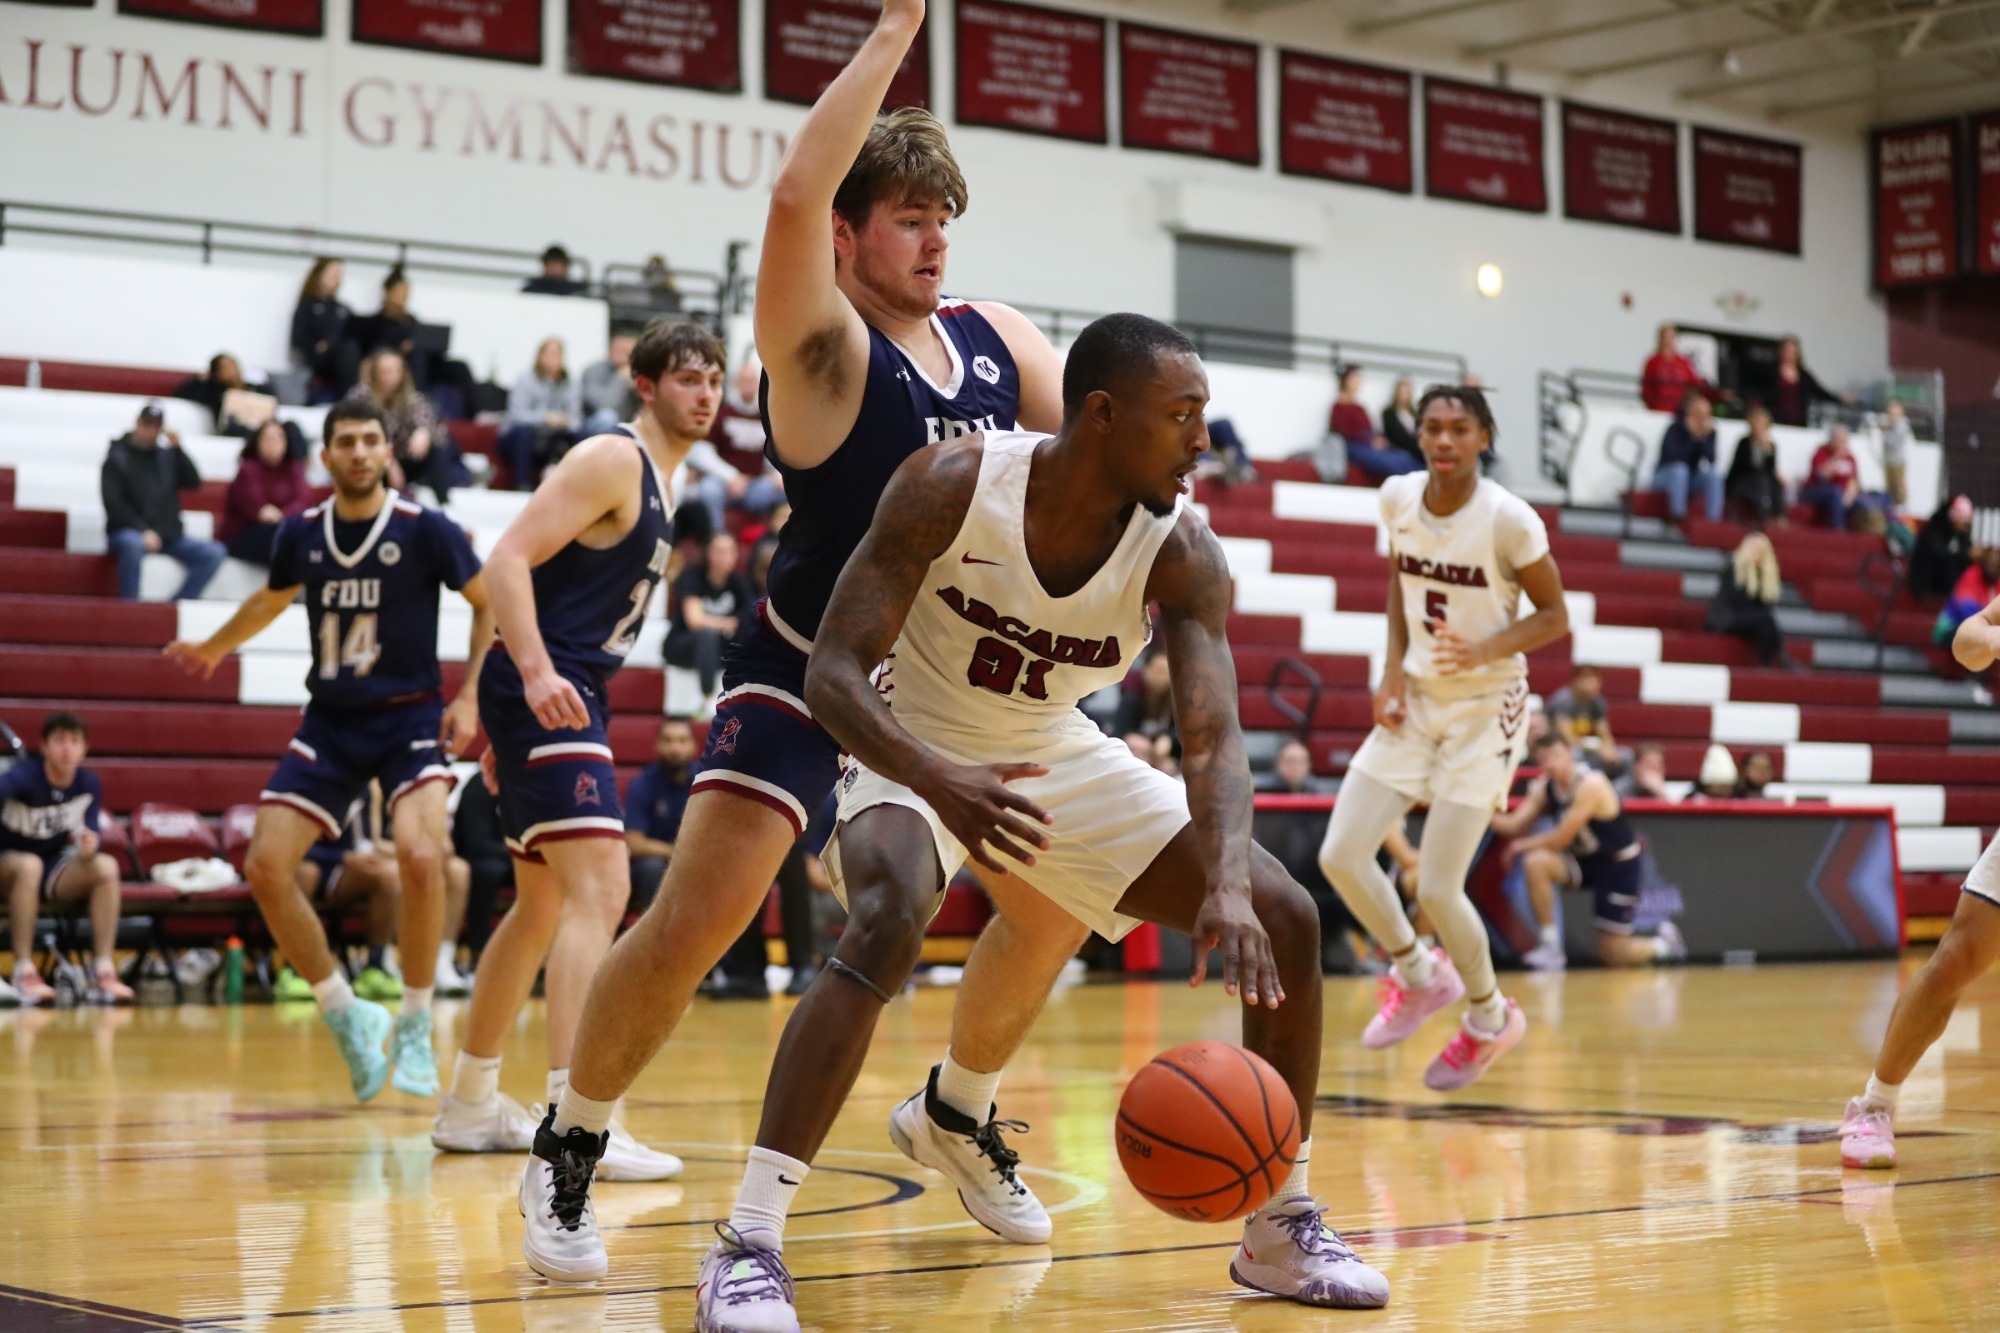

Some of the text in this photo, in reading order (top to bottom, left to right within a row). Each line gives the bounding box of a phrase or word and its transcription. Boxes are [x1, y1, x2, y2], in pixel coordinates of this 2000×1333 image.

[0, 38, 790, 196] LUMNI GYMNASIU
[321, 578, 381, 608] FDU
[935, 585, 1122, 668] ARCADIA
[1423, 589, 1448, 637] 5
[318, 612, 382, 680] 14
